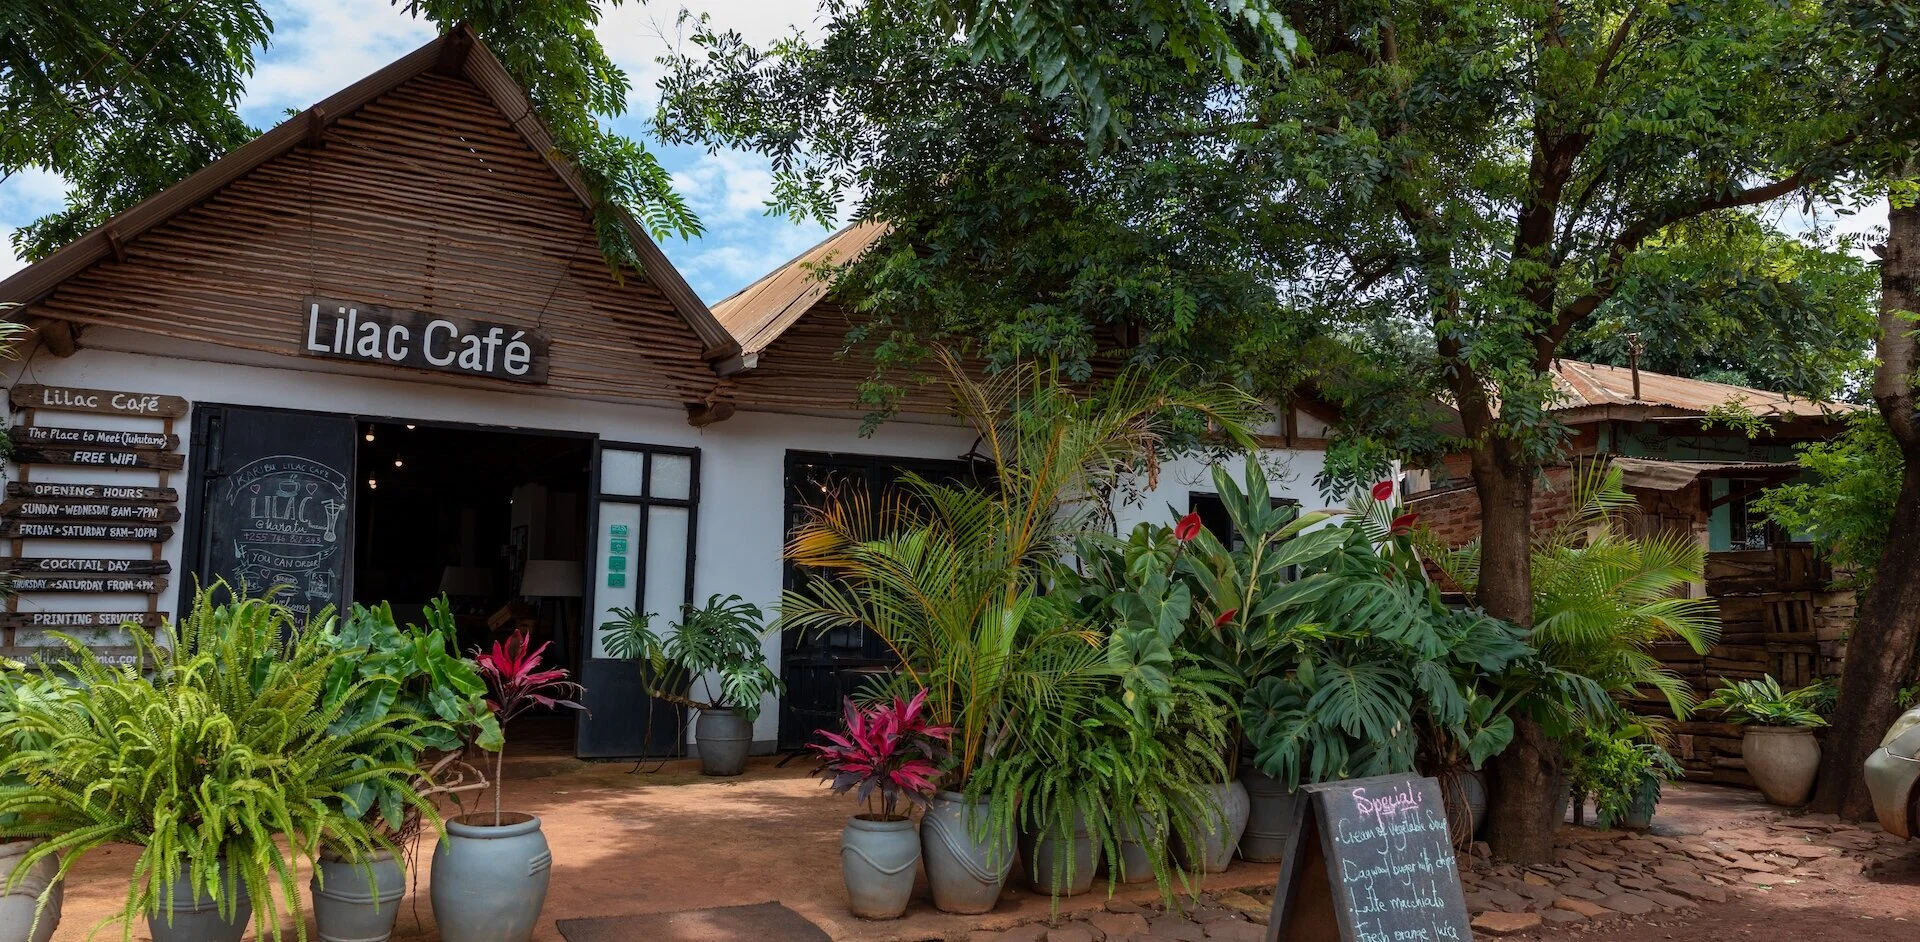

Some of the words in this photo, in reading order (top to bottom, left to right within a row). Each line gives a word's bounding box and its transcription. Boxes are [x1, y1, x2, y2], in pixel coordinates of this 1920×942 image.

[307, 303, 410, 362] Lilac
[423, 319, 531, 376] Café
[43, 389, 99, 408] Lilac
[111, 393, 161, 413] Café
[28, 427, 47, 439] The
[50, 428, 79, 441] Place
[82, 431, 93, 442] to
[73, 451, 106, 464] FREE
[110, 453, 138, 466] WIFI
[282, 463, 306, 472] LILAC
[35, 485, 95, 497] OPENING
[103, 487, 144, 499] HOURS
[250, 495, 313, 523] LILAC
[243, 532, 268, 542] +255
[39, 559, 104, 572] COCKTAIL
[107, 560, 131, 572] DAY
[252, 552, 271, 564] YOU
[273, 557, 294, 568] CAN
[294, 559, 319, 568] ORDER
[12, 579, 47, 589] THURSDAY
[107, 580, 134, 591] FROM
[33, 613, 93, 625] PRINTING
[98, 613, 144, 625] SERVICES
[1338, 817, 1376, 845] Cream
[1417, 847, 1434, 875] with
[1435, 841, 1456, 884] chips
[1350, 887, 1388, 916] Latte
[1389, 880, 1445, 911] macchiato
[1355, 917, 1390, 942] Fresh
